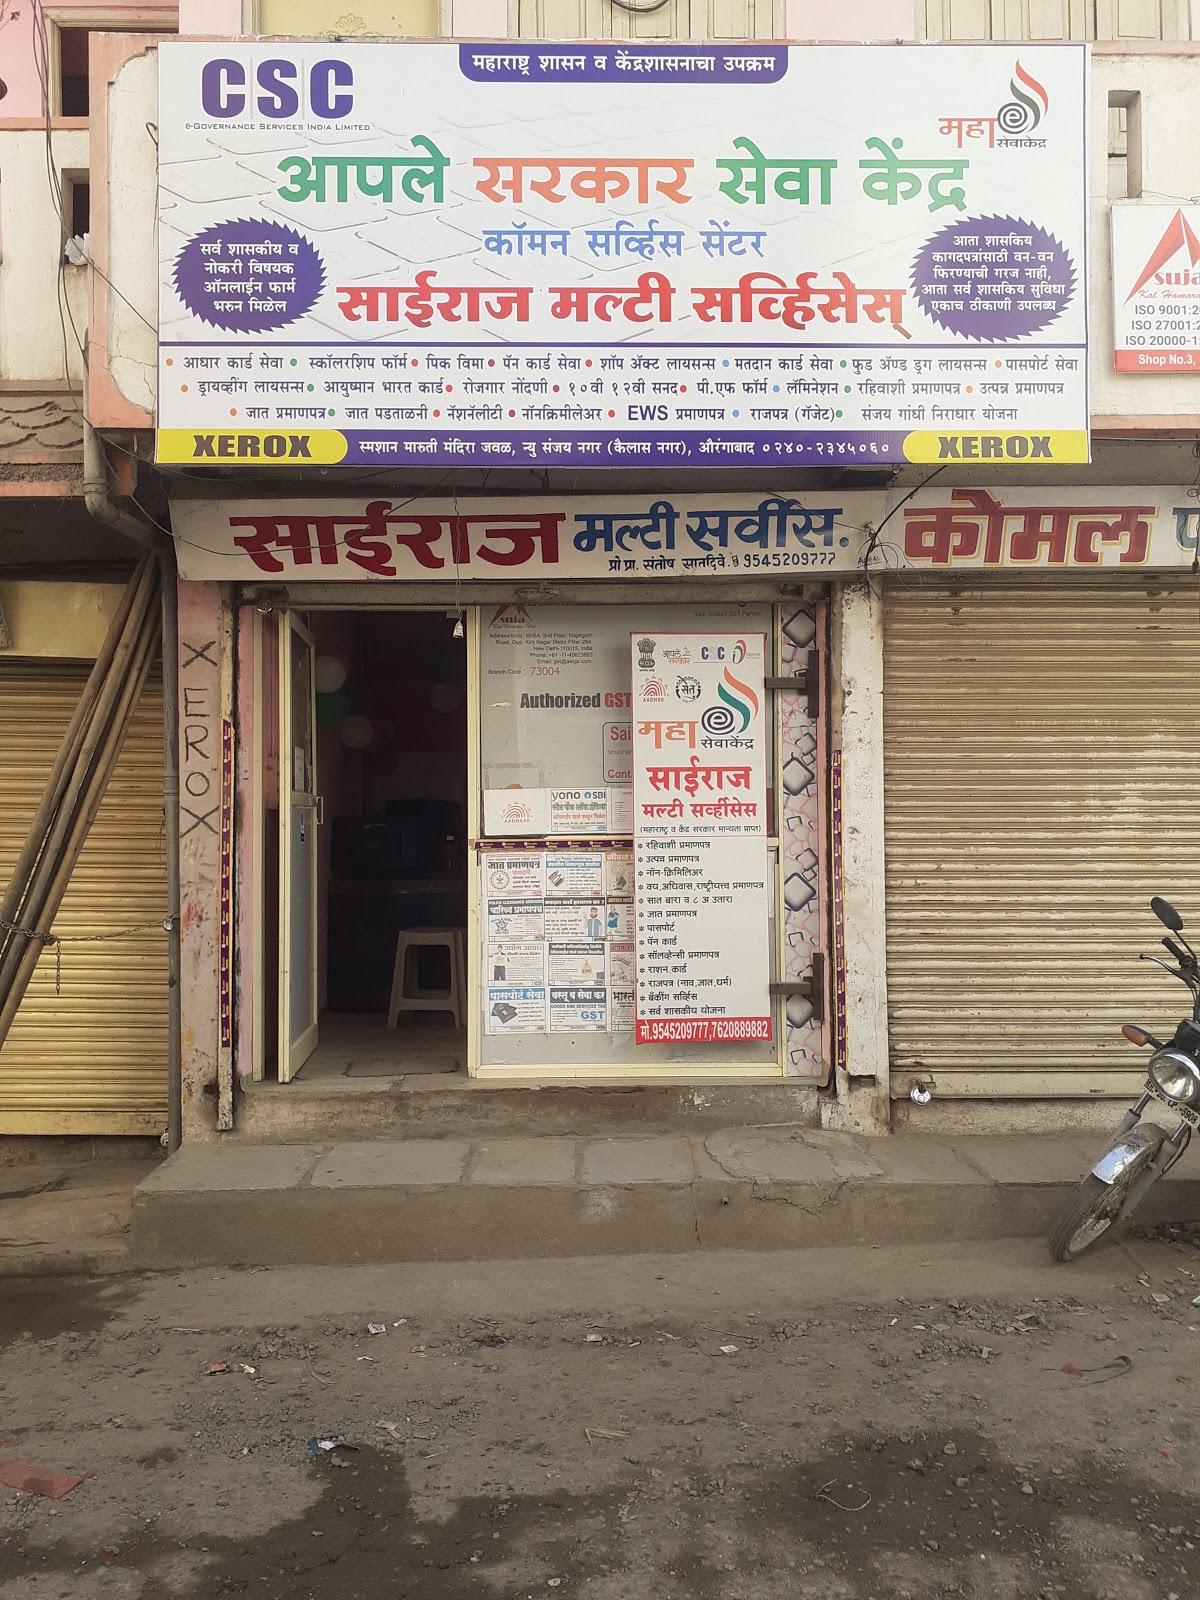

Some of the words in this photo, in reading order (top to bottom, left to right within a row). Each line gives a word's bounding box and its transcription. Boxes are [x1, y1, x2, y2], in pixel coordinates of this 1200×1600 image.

[472, 54, 530, 75] महाराष्ट्र
[539, 54, 586, 71] शासन
[594, 55, 606, 70] व
[615, 50, 715, 71] केंद्रशासनाचा
[724, 55, 775, 71] उपक्रम
[202, 59, 353, 119] CSC
[938, 118, 998, 148] महा
[277, 135, 451, 203] आपले
[473, 157, 694, 204] सरकार
[717, 137, 837, 206] सेवा
[859, 137, 969, 213] केंद्र
[200, 240, 222, 255] सर्व
[227, 240, 283, 255] शासकीय
[288, 244, 299, 255] व
[482, 221, 570, 256] कॉमन
[585, 219, 685, 261] सर्व्हिस
[700, 219, 767, 258] सेंटर
[953, 236, 979, 246] आता
[984, 233, 1032, 247] शासकिय
[204, 259, 243, 274] नोकरी
[248, 259, 295, 274] विषयक
[933, 265, 988, 279] फिरण्याची
[994, 268, 1019, 279] गरज
[204, 277, 263, 295] ऑनलाईन
[268, 278, 296, 294] फार्म
[922, 284, 947, 295] आता
[953, 281, 972, 295] सर्व
[978, 282, 1025, 295] शासकिय
[1030, 282, 1065, 298] सुविधा
[248, 297, 287, 312] मिळेल
[337, 270, 534, 327] साईराज
[549, 271, 675, 324] मल्टी
[931, 300, 964, 313] एकाच
[969, 297, 1011, 311] ठीकाणी
[1135, 305, 1155, 315] ISO
[1131, 320, 1151, 331] ISO
[1125, 336, 1146, 346] ISO
[183, 357, 221, 369] आधार
[227, 352, 253, 369] कार्ड
[260, 352, 283, 369] सेवा
[309, 353, 375, 370] स्कॉलरशिप
[382, 353, 408, 369] फॉर्म
[426, 354, 451, 369] पिक
[457, 354, 484, 370] विमा
[526, 353, 551, 370] कार्ड
[557, 354, 581, 370] सेवा
[600, 355, 624, 370] शॉप
[666, 358, 716, 370] लायसन्स
[734, 359, 772, 371] मतदान
[778, 354, 803, 371] कार्ड
[810, 355, 833, 371] सेवा
[852, 358, 873, 373] फुड
[938, 359, 987, 371] लायसन्स
[1005, 355, 1049, 372] पासपोर्ट
[1055, 356, 1079, 371] सेवा
[1138, 354, 1166, 366] Shop
[254, 382, 304, 393] लायसन्स
[324, 381, 374, 397] आयुष्मान
[382, 381, 411, 393] भारत
[418, 377, 443, 394] कार्ड
[462, 377, 505, 394] रोजगार
[511, 378, 548, 394] नोंदणी
[652, 383, 678, 395] सनद
[742, 378, 768, 395] फॉर्म
[857, 378, 905, 395] रहिवाशी
[912, 383, 961, 395] प्रमाणपत्र
[979, 383, 1009, 395] उत्पन्न
[1015, 383, 1064, 395] प्रमाणपत्र
[246, 407, 269, 419] जात
[276, 408, 326, 420] प्रमाणपत्र
[345, 407, 368, 420] जात
[628, 405, 669, 420] EWS
[675, 408, 725, 422] प्रमाणपत्र
[750, 408, 788, 421] राजपत्र
[861, 404, 892, 421] संजय
[898, 403, 925, 421] गांधी
[932, 403, 975, 420] निराधार
[982, 404, 1018, 421] योजना
[193, 435, 312, 457] XEROX
[359, 440, 398, 454] स्मशान
[542, 438, 571, 453] संजय
[577, 441, 601, 453] नगर
[698, 438, 754, 454] औरंगाबाद
[938, 436, 1053, 459] XEROX
[904, 488, 1159, 565] कोमल
[230, 500, 567, 576] साईराज
[573, 500, 679, 552] मल्टी
[743, 552, 836, 568] 9545209777
[520, 693, 601, 709] Authorized
[637, 720, 698, 749] महा
[645, 755, 752, 797] साईराज
[641, 798, 684, 818] मल्टी
[679, 841, 711, 849] प्रमाणपत्र
[668, 855, 700, 863] प्रमाणपत्र
[666, 910, 697, 918] प्रमाणपत्र
[688, 951, 720, 959] प्रमाणपत्र
